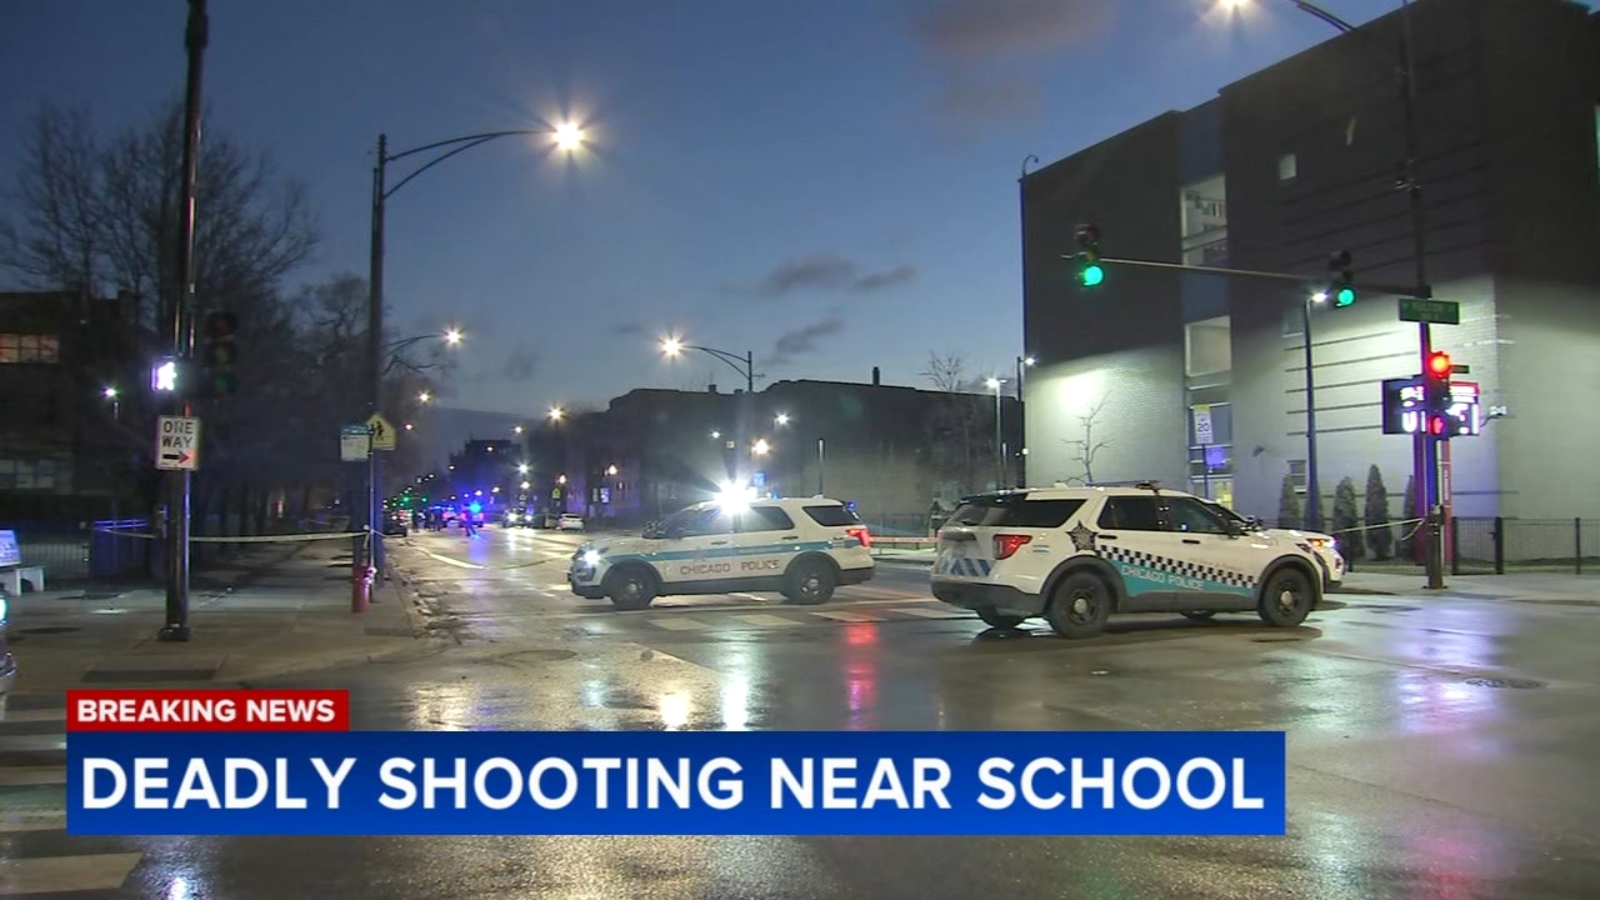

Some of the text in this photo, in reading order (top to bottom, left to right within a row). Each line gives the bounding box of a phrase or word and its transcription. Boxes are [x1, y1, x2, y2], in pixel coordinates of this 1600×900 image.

[163, 421, 194, 434] ONE
[162, 436, 193, 448] WAY
[680, 560, 780, 575] CHICAGO POLICE
[1121, 564, 1204, 590] CHICAGO POLICE
